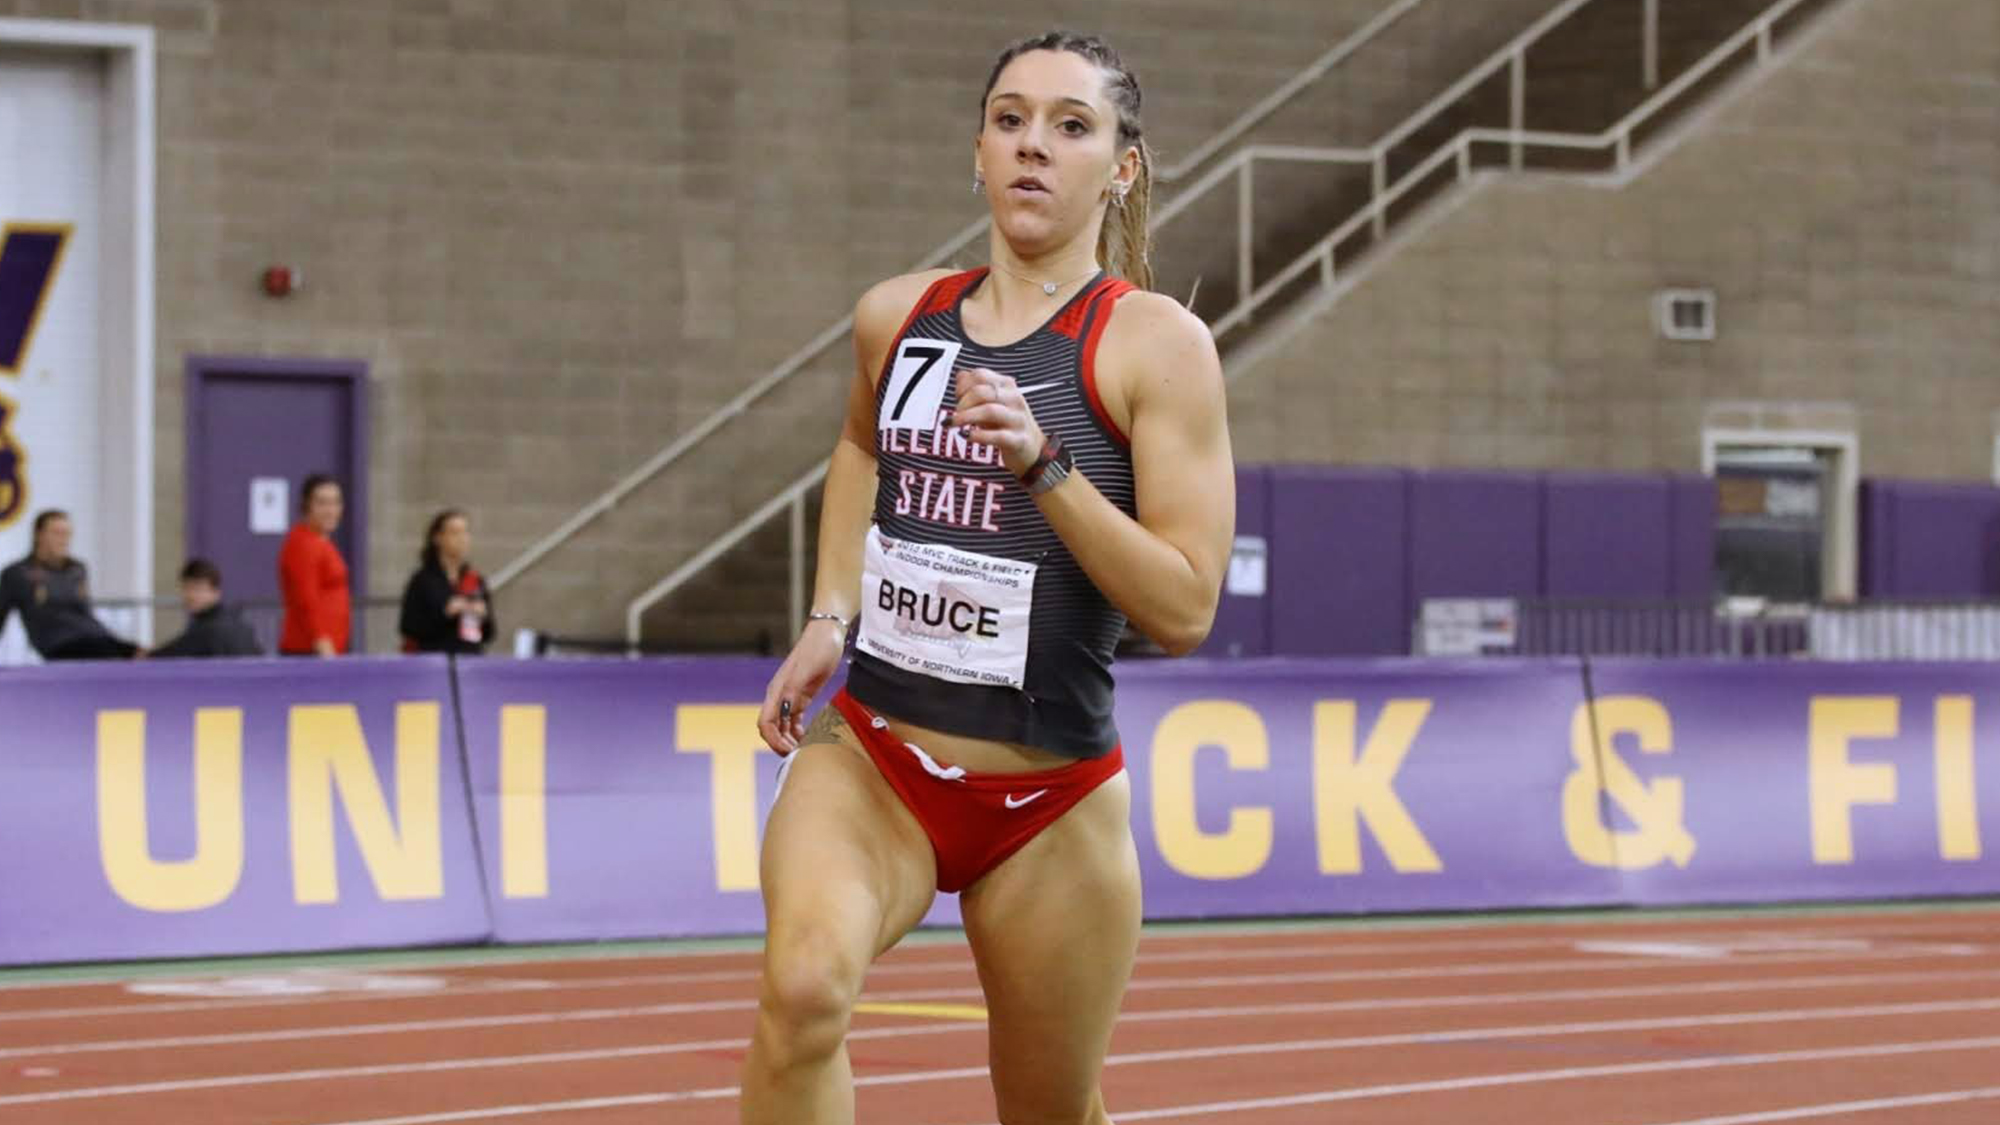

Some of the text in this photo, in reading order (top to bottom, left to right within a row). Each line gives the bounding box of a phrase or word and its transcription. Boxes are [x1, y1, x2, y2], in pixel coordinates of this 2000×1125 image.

[891, 346, 946, 421] 7
[896, 470, 1004, 532] STATE
[896, 551, 1019, 588] INDOOR CHAMPIONSHIPS
[948, 553, 979, 568] TRACK
[982, 561, 989, 570] &
[992, 564, 1021, 576] FIELD
[878, 578, 1001, 638] BRUCE
[868, 638, 1010, 684] UNIVERSITY OF NORTHERN IOWA
[96, 701, 549, 912] UNI
[675, 699, 1444, 892] TCK
[1562, 694, 1697, 871] &
